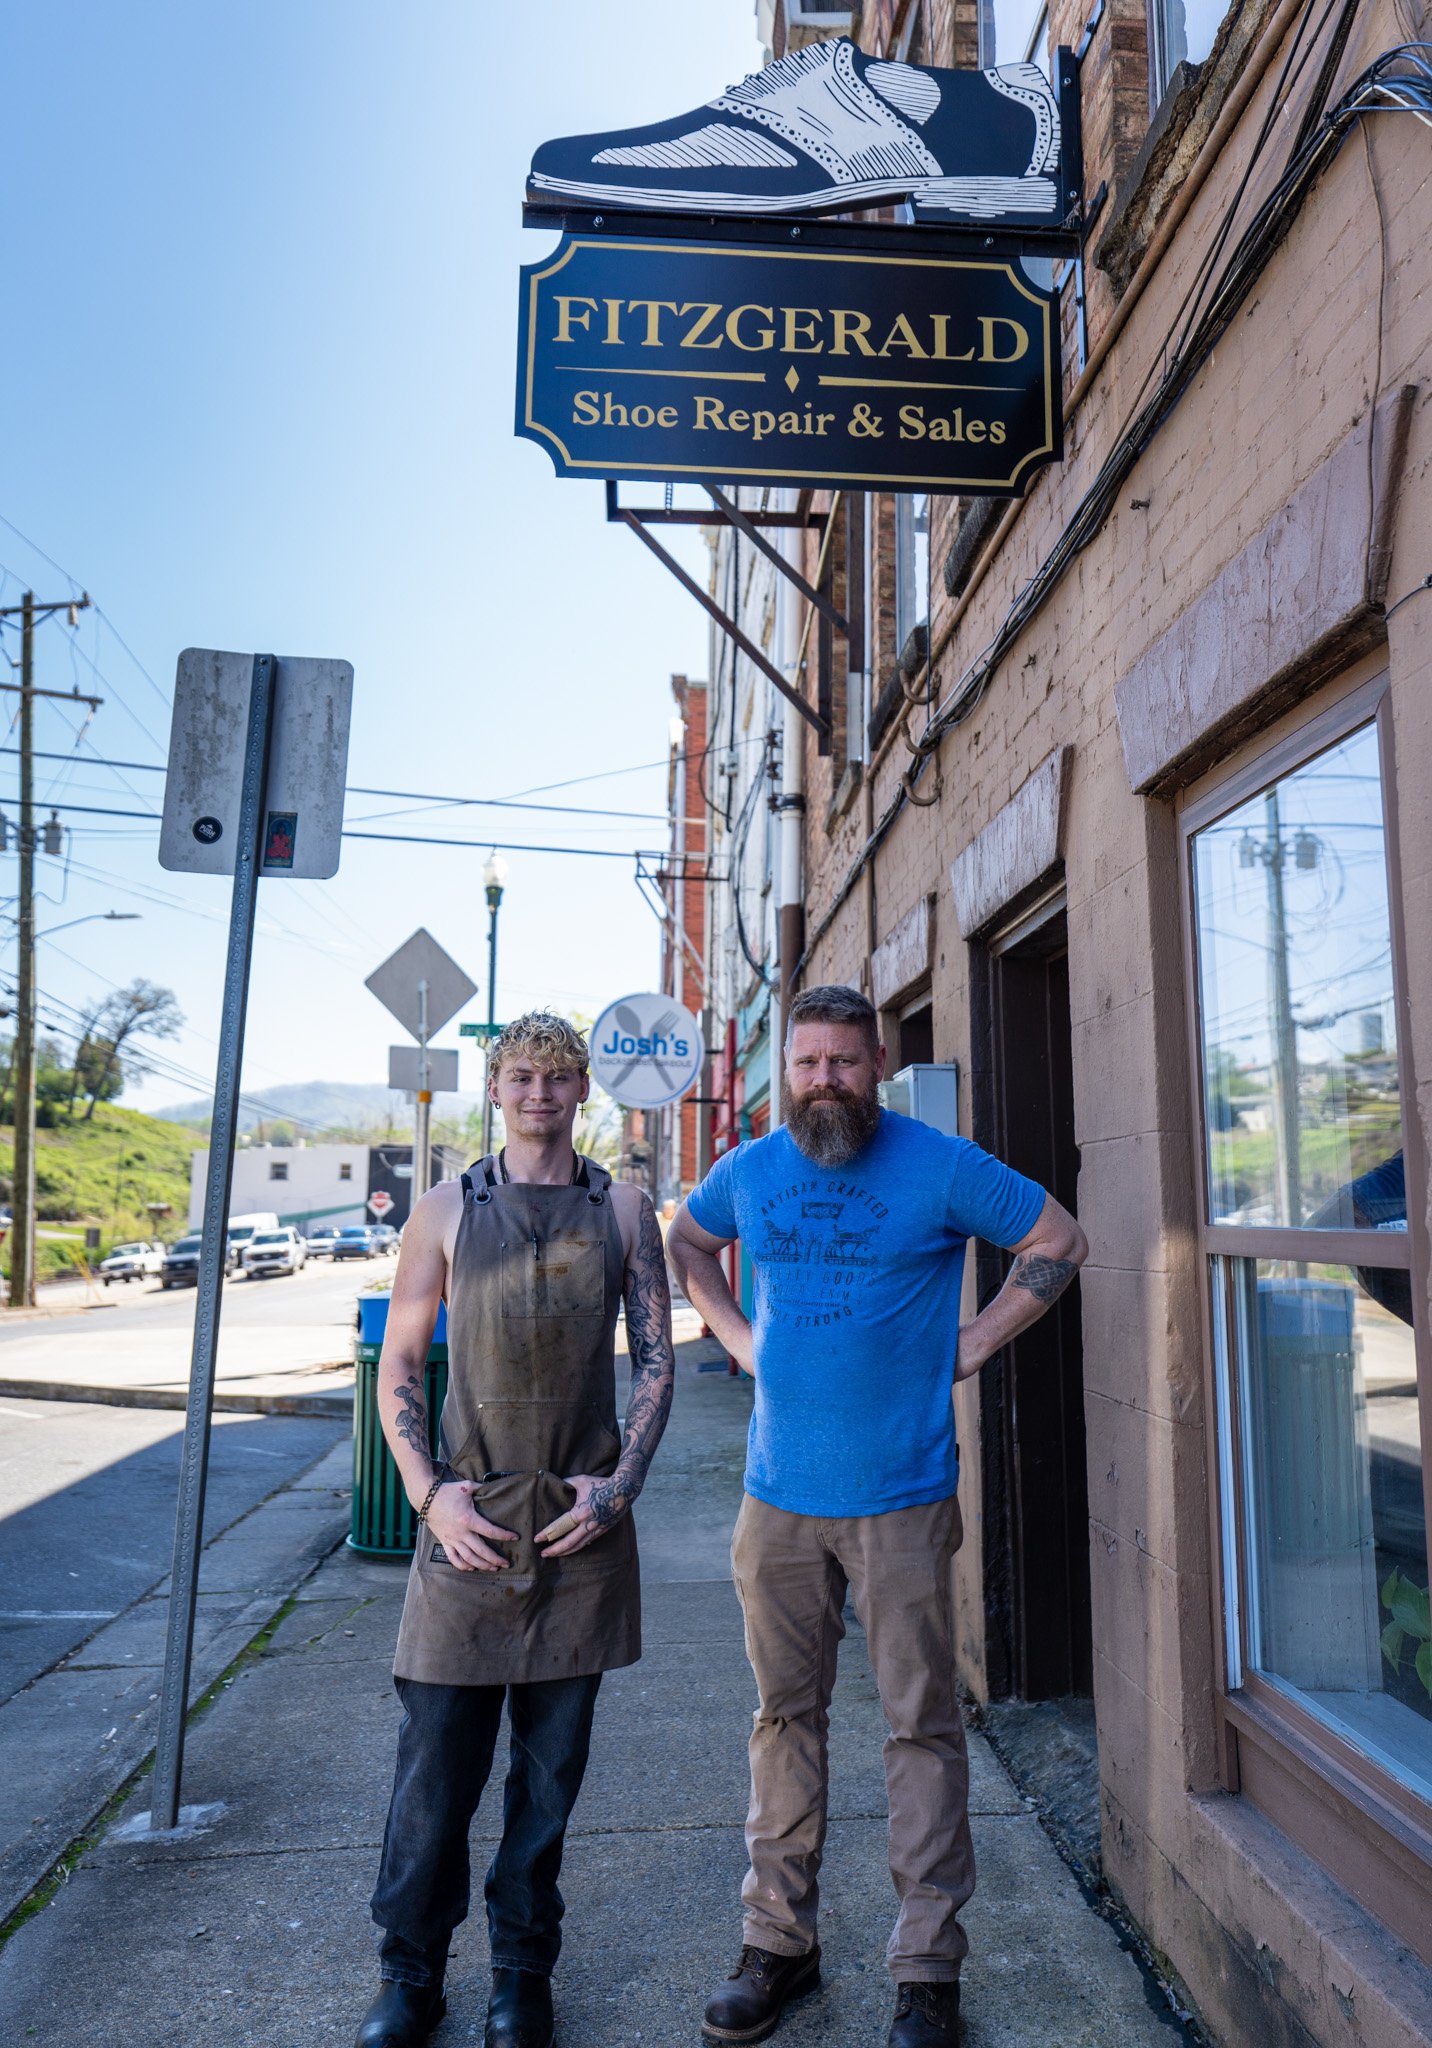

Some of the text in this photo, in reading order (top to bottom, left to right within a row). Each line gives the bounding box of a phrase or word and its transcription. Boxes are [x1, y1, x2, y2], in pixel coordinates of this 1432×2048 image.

[552, 295, 1029, 363] FITZGERALD
[572, 390, 1007, 444] Shoe Repair & Sales
[603, 1031, 688, 1057] Josh's
[761, 1180, 818, 1217] ARTISAN
[827, 1181, 889, 1219] CRAFTED
[823, 1271, 878, 1287] GOODS
[794, 1306, 852, 1328] STRONG
